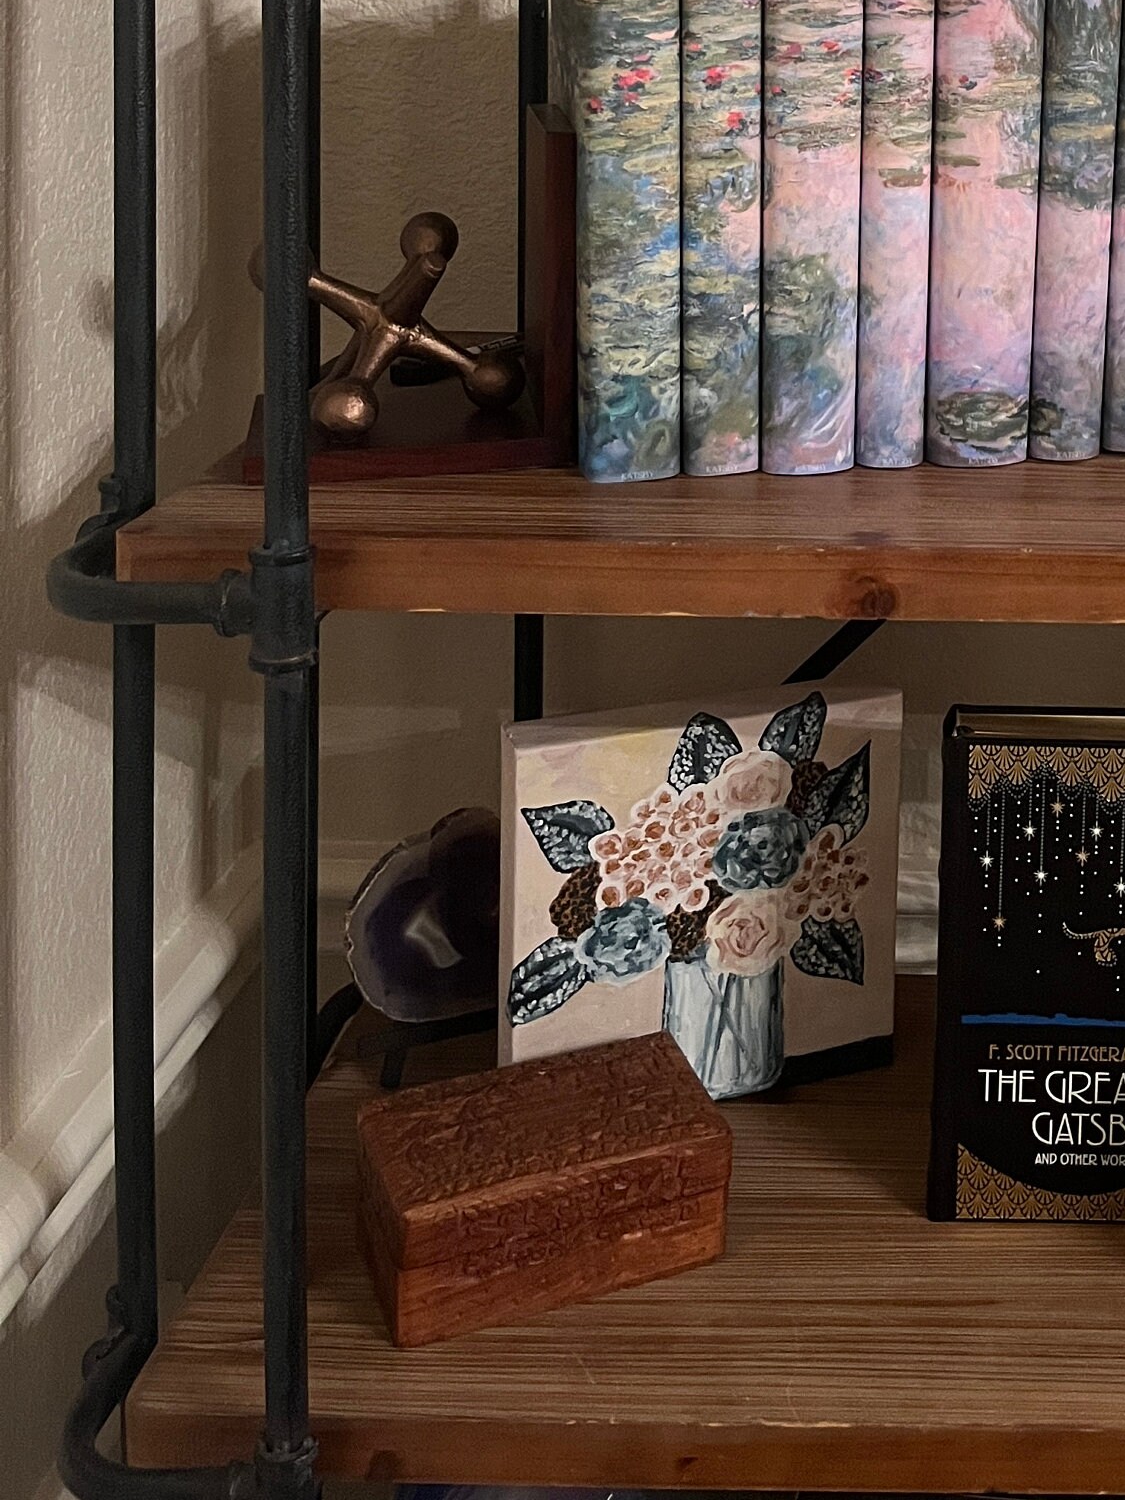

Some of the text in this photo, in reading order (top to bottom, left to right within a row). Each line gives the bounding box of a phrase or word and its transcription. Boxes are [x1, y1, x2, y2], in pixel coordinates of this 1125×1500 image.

[989, 1045, 1000, 1059] F.
[1006, 1044, 1053, 1060] SCOTT
[978, 1069, 1036, 1102] THE
[1035, 1153, 1057, 1164] AND
[1060, 1153, 1097, 1165] OTHER
